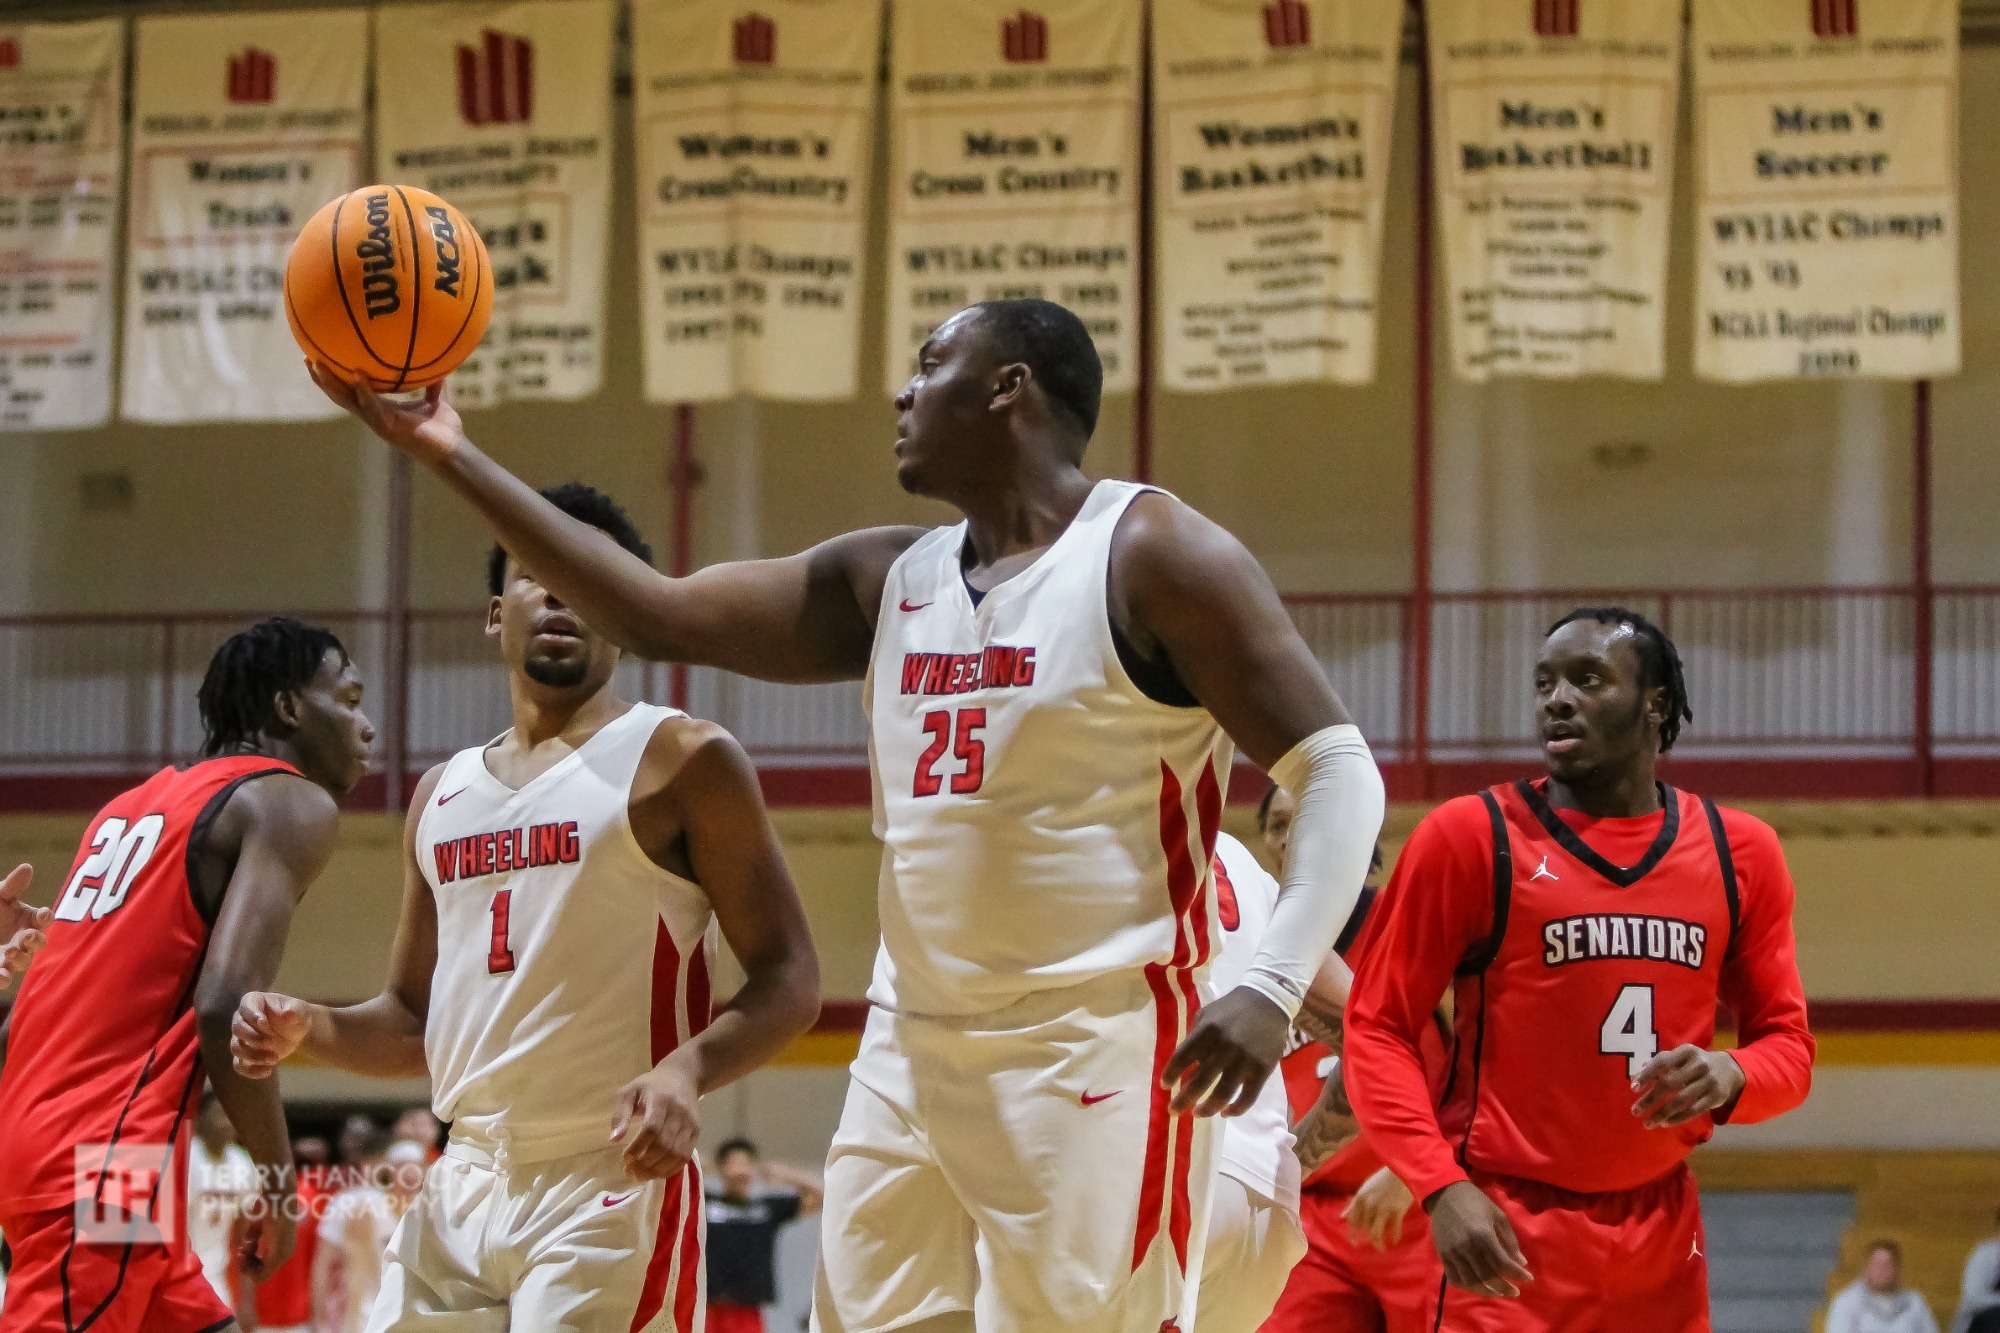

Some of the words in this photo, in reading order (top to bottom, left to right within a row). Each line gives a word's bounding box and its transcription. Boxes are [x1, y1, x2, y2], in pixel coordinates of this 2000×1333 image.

[964, 130, 1067, 157] Men's
[1198, 116, 1360, 148] Women's
[1501, 101, 1604, 129] Men's
[1773, 105, 1883, 134] Men's
[998, 167, 1119, 196] Country
[1756, 151, 1889, 180] Soccer
[357, 191, 400, 321] Wilson
[425, 206, 460, 299] NCAA
[913, 708, 986, 798] 25
[54, 813, 165, 922] 20
[433, 820, 580, 885] WHEELING
[487, 889, 516, 974] 1
[1542, 913, 1708, 969] SENATORS
[1600, 983, 1659, 1079] 4
